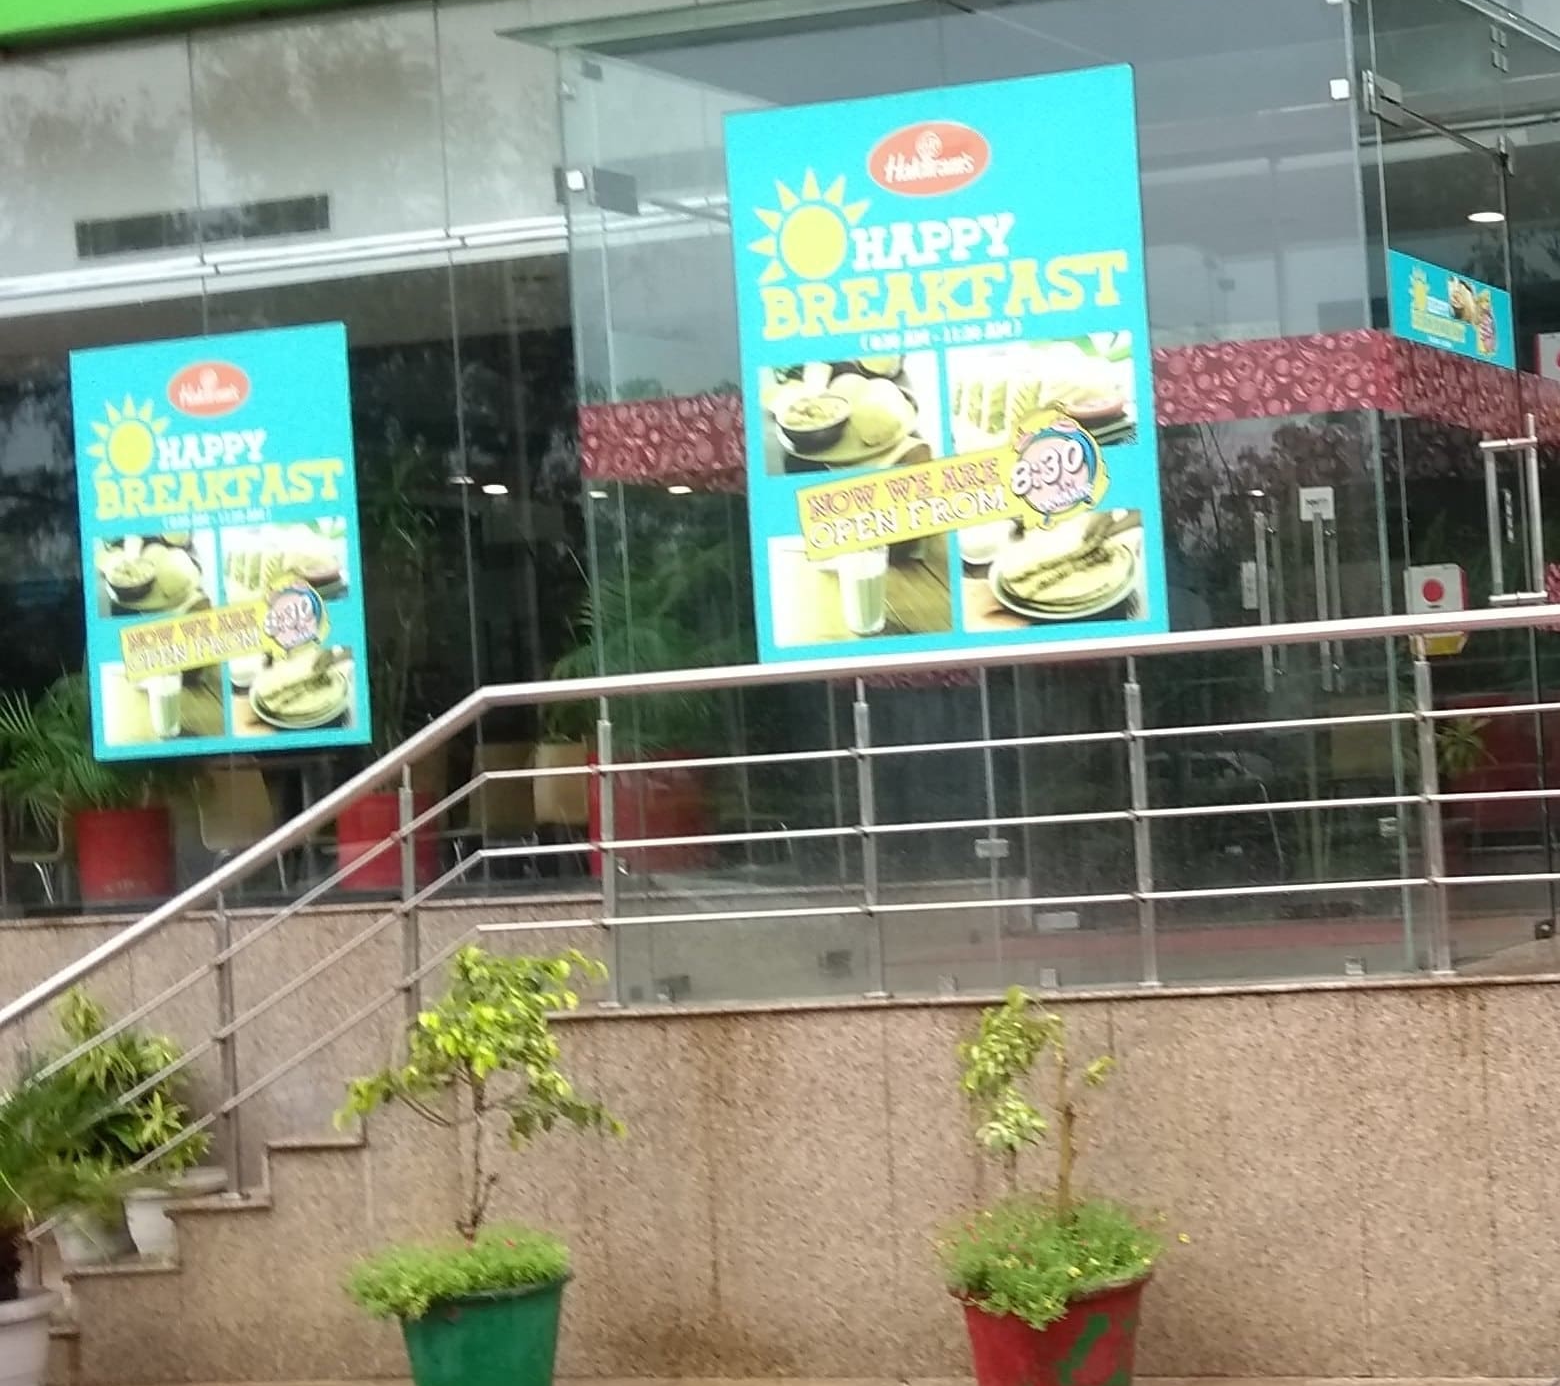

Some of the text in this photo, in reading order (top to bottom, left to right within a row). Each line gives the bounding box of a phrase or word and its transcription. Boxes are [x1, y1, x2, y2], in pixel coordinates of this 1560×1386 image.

[850, 213, 1016, 273] HAPPY
[757, 250, 1128, 341] BREAKFAST
[157, 428, 266, 471] HAPPY
[807, 439, 1085, 521] NOW WE ARE 8:30
[94, 458, 344, 521] BREAKFAST
[809, 504, 899, 550] OPEN
[907, 486, 1008, 531] FROM
[126, 625, 175, 652] NOW
[179, 617, 214, 639] WE
[217, 607, 257, 632] ARE
